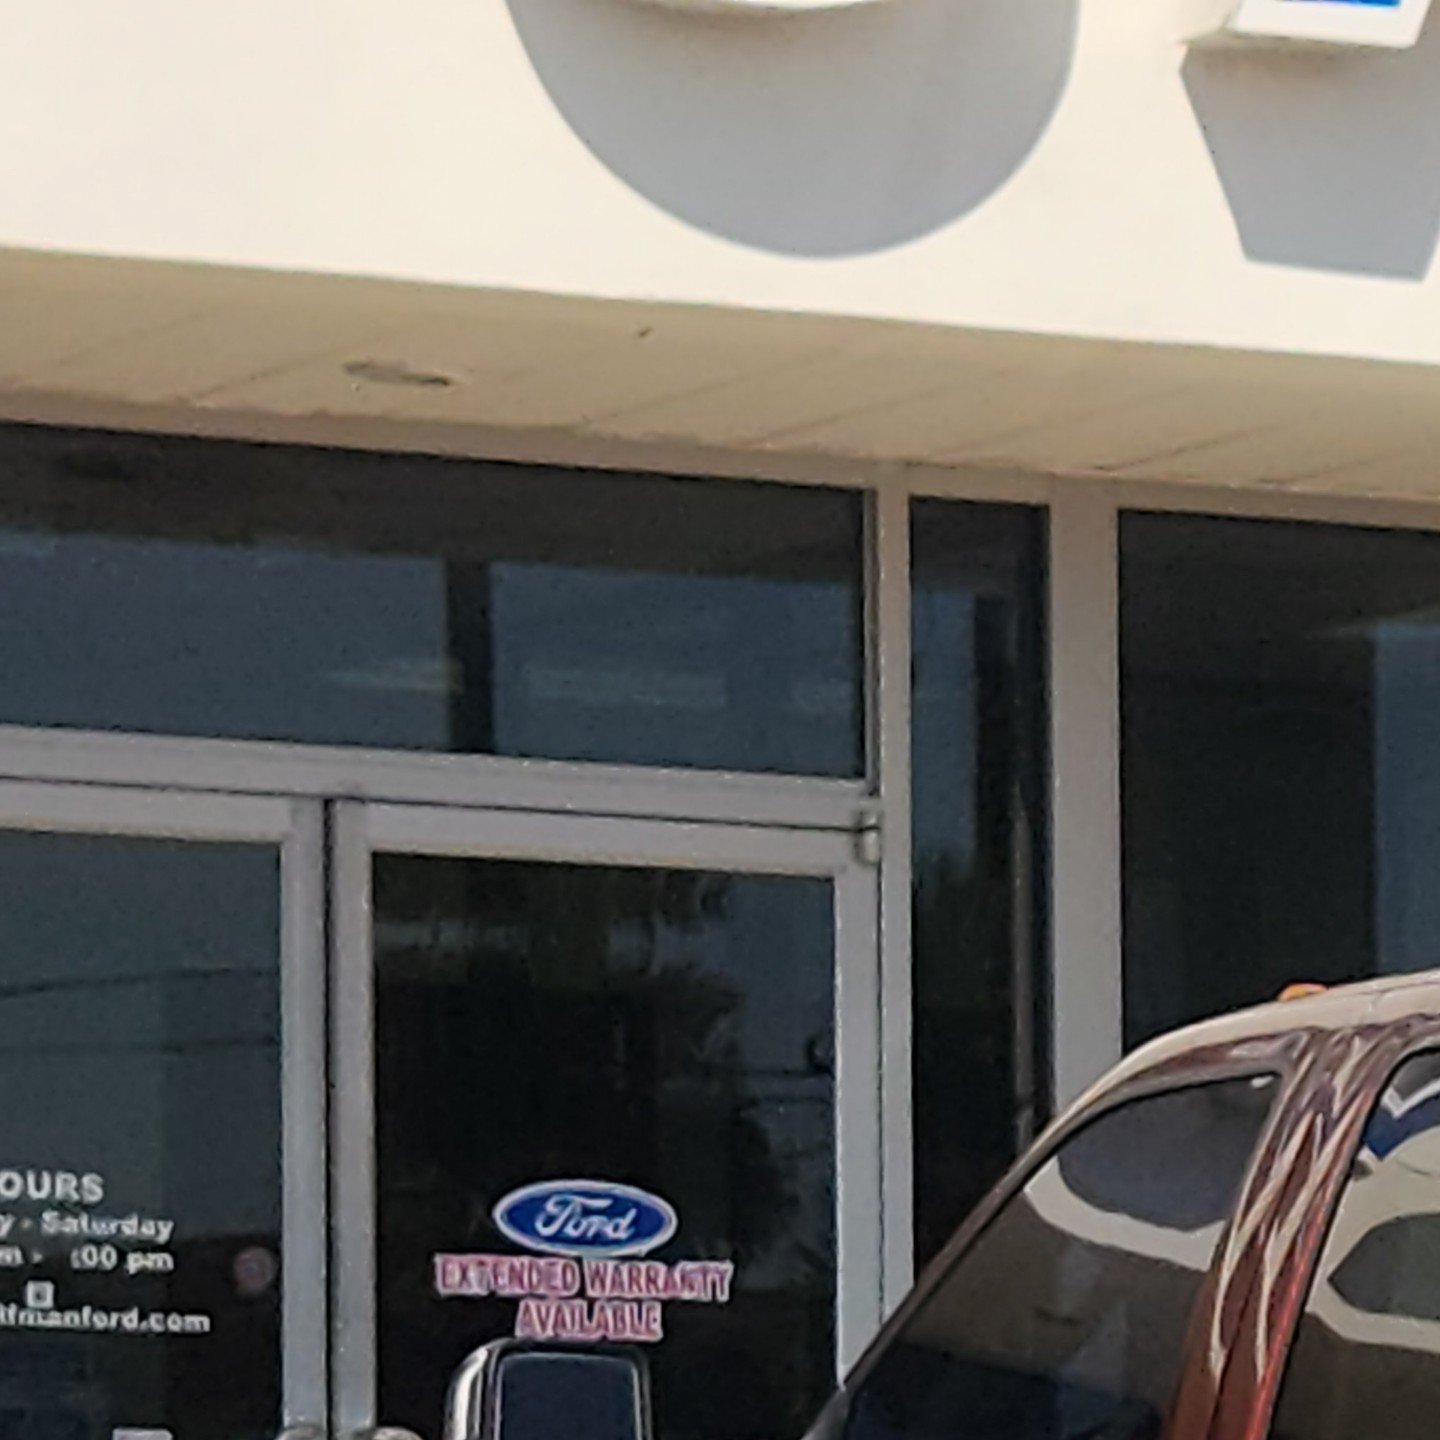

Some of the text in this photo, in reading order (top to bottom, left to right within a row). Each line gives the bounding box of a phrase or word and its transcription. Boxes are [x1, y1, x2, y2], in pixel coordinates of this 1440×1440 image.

[41, 1209, 174, 1244] Saturday
[534, 1194, 636, 1240] Ford
[126, 1252, 174, 1275] pm
[435, 1253, 734, 1303] EXTENDED WARRANTY
[514, 1299, 664, 1343] AVAILABLE
